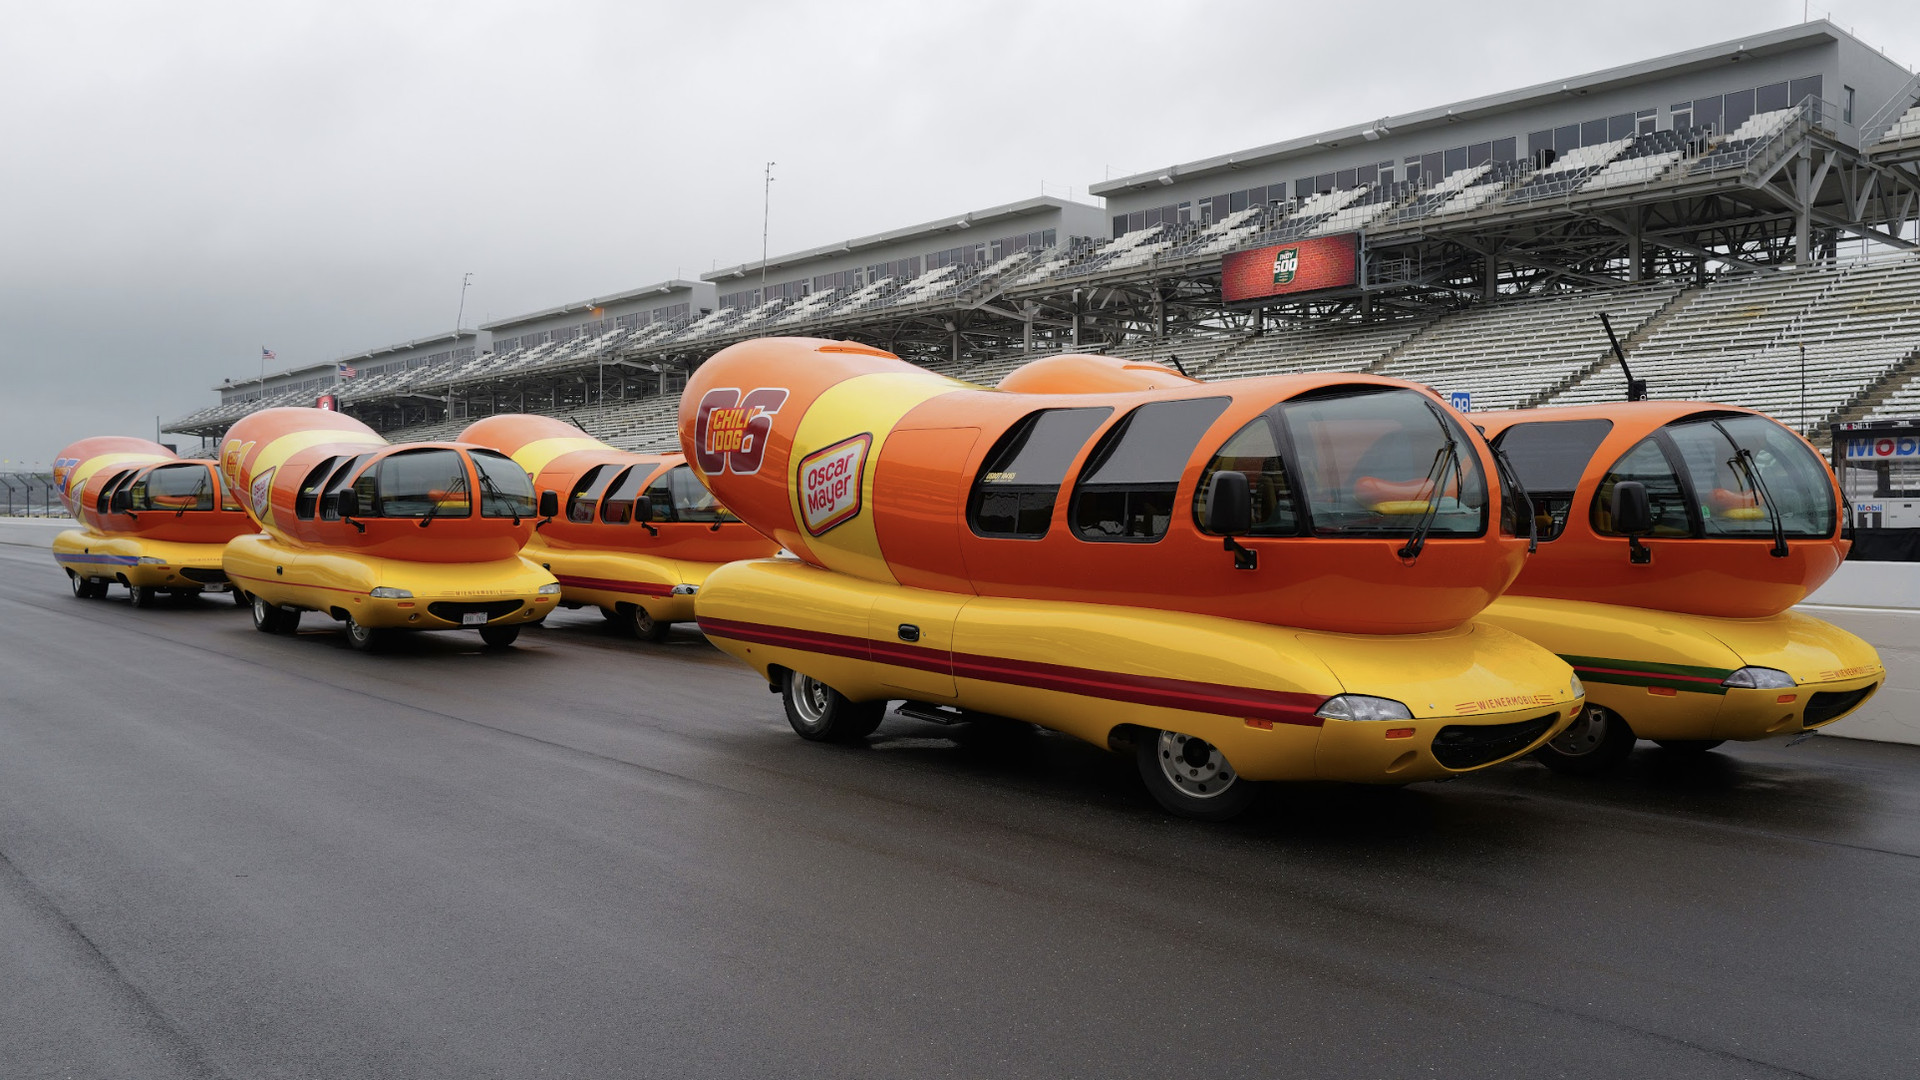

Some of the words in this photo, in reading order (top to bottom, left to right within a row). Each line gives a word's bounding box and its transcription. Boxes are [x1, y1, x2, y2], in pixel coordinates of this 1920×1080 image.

[1280, 252, 1294, 260] INDY
[1273, 258, 1297, 273] 500
[713, 408, 754, 430] CHILI
[715, 430, 743, 451] DOG
[807, 453, 855, 491] Oscar
[808, 475, 852, 515] Mayer
[1833, 665, 1868, 678] WIENERMOBILE
[1476, 695, 1541, 710] WIENERMOBILE
